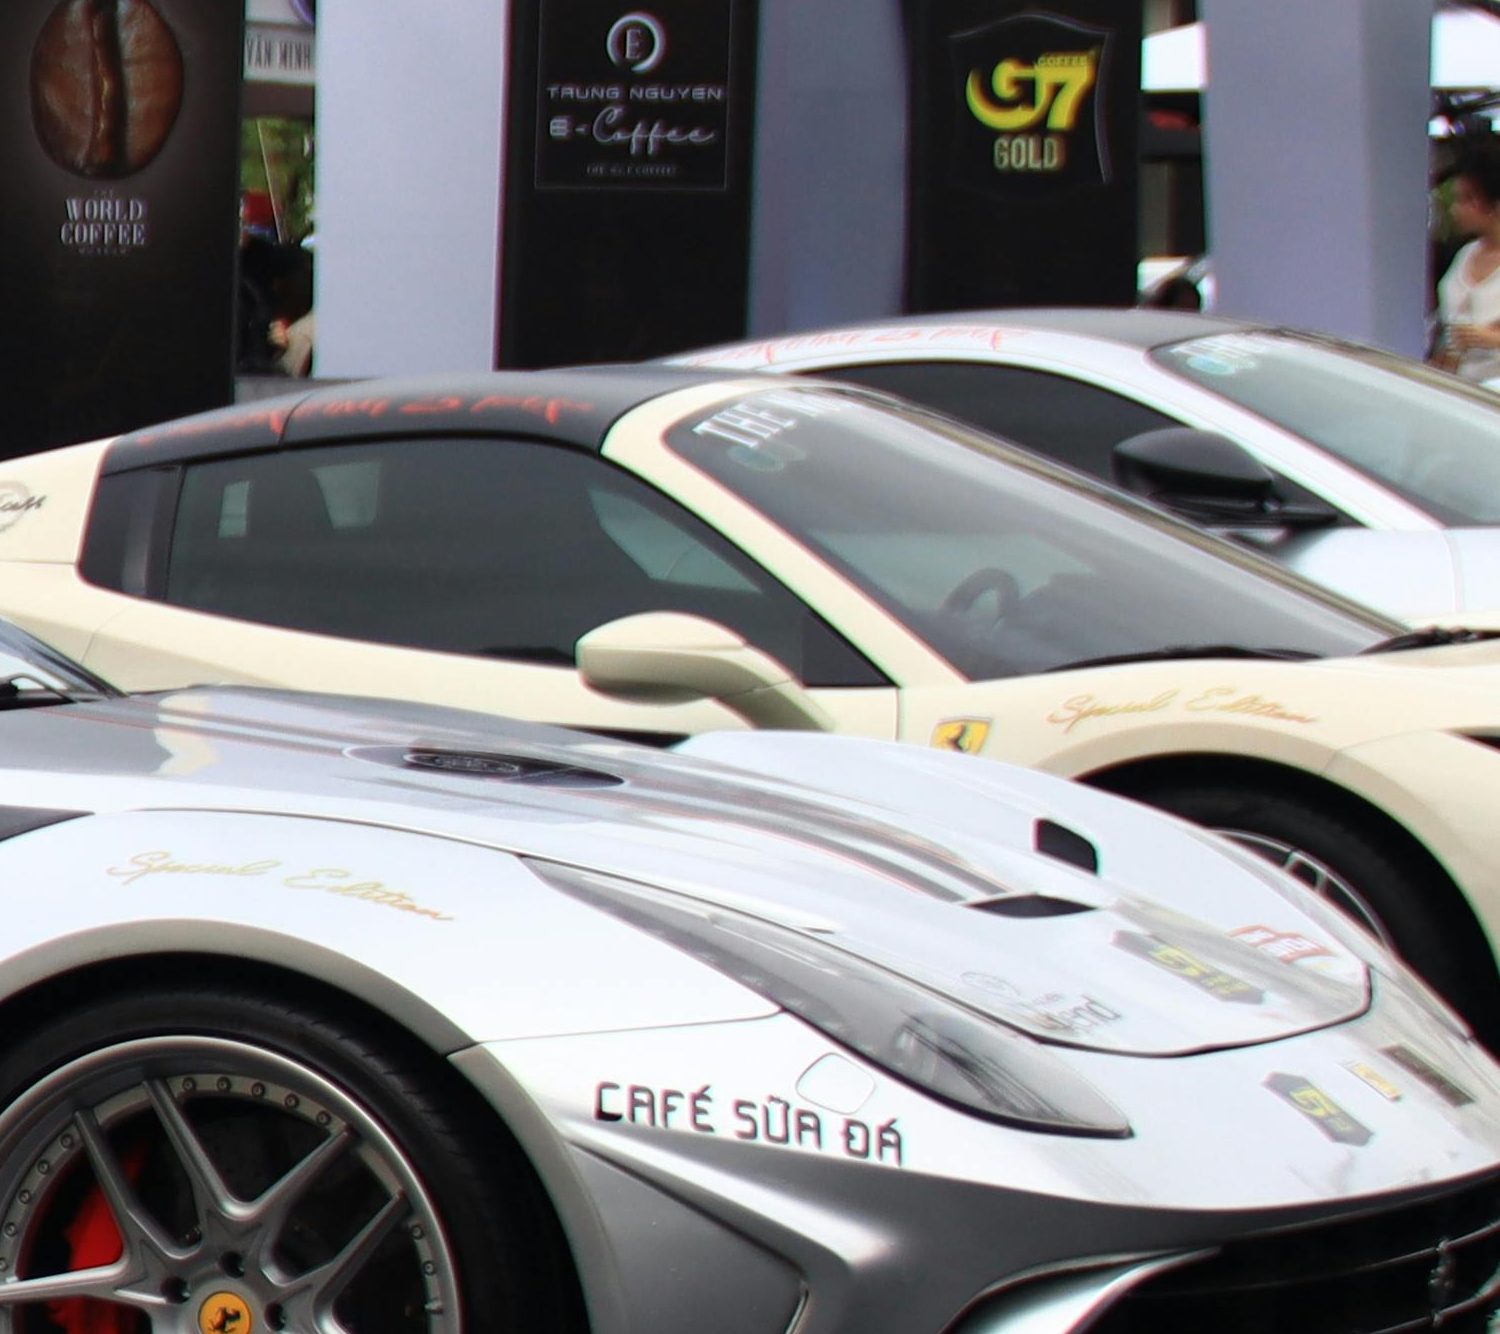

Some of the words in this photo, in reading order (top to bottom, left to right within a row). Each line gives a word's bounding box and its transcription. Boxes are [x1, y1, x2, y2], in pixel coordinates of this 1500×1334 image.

[1036, 55, 1089, 67] COFFEE
[547, 86, 621, 101] TRUNG
[629, 86, 723, 101] NGUYEN
[965, 57, 1094, 132] G7
[993, 137, 1061, 171] GOLD
[65, 198, 144, 221] WORLD
[59, 222, 146, 246] COFFEE
[1046, 688, 1181, 734] Special
[106, 850, 284, 886] Special
[283, 867, 456, 923] Edition
[593, 1080, 716, 1133] CAFÉ
[732, 1093, 822, 1151] SỮA
[839, 1116, 903, 1168] ĐÁ
